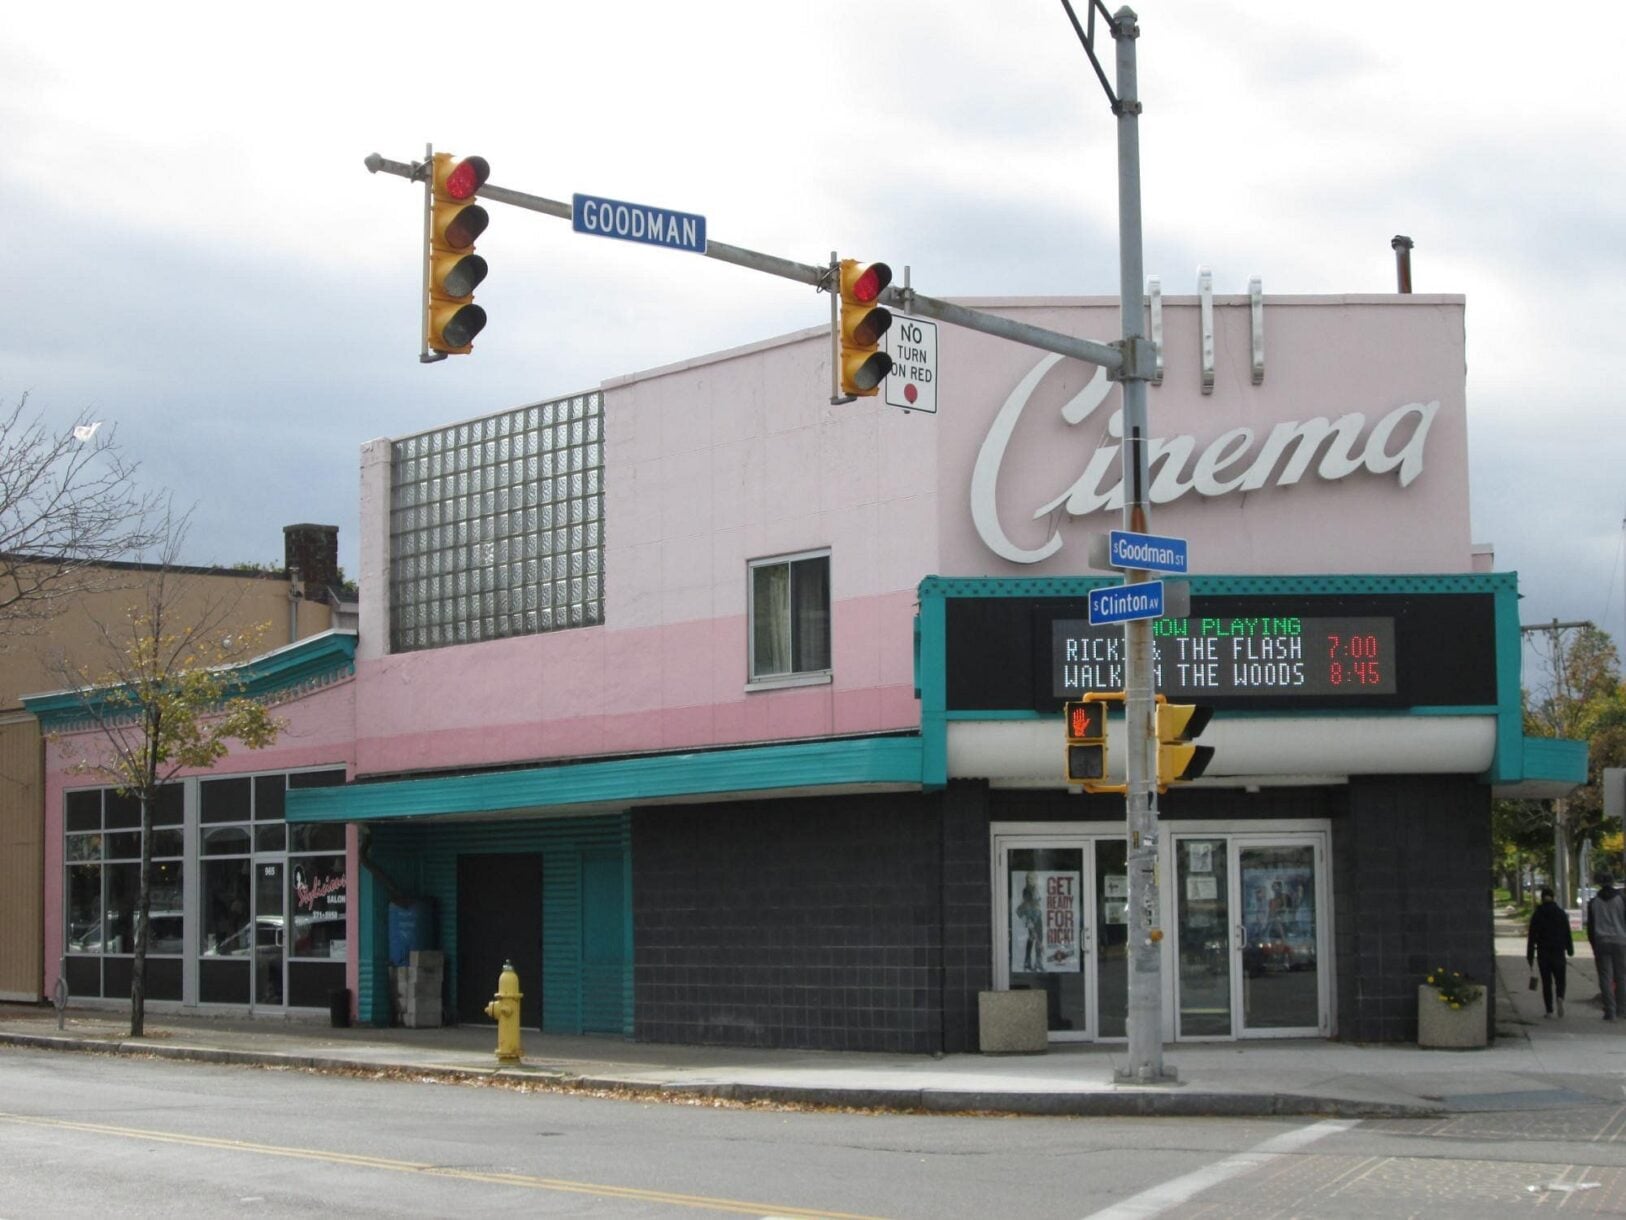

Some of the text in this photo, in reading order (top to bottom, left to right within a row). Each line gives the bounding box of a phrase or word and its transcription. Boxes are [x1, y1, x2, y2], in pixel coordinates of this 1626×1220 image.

[583, 200, 696, 247] GOODMAN
[901, 324, 922, 344] NO
[897, 345, 927, 363] TURN
[891, 362, 932, 383] ON RED
[970, 339, 1440, 564] Cinema
[1113, 539, 1184, 566] S Goodman ST
[1094, 594, 1159, 615] S Clinton AV
[1202, 618, 1301, 636] PLAYING
[1177, 637, 1219, 660] THE
[1233, 636, 1301, 660] FLASH
[1328, 635, 1377, 658] 7:00
[1064, 664, 1121, 688] WALK
[1177, 663, 1219, 687] THE
[1234, 662, 1304, 687] WOODS
[1331, 661, 1379, 684] 8:45
[1047, 877, 1073, 896] GET
[1047, 896, 1074, 909] READY
[1047, 910, 1074, 928] FOR
